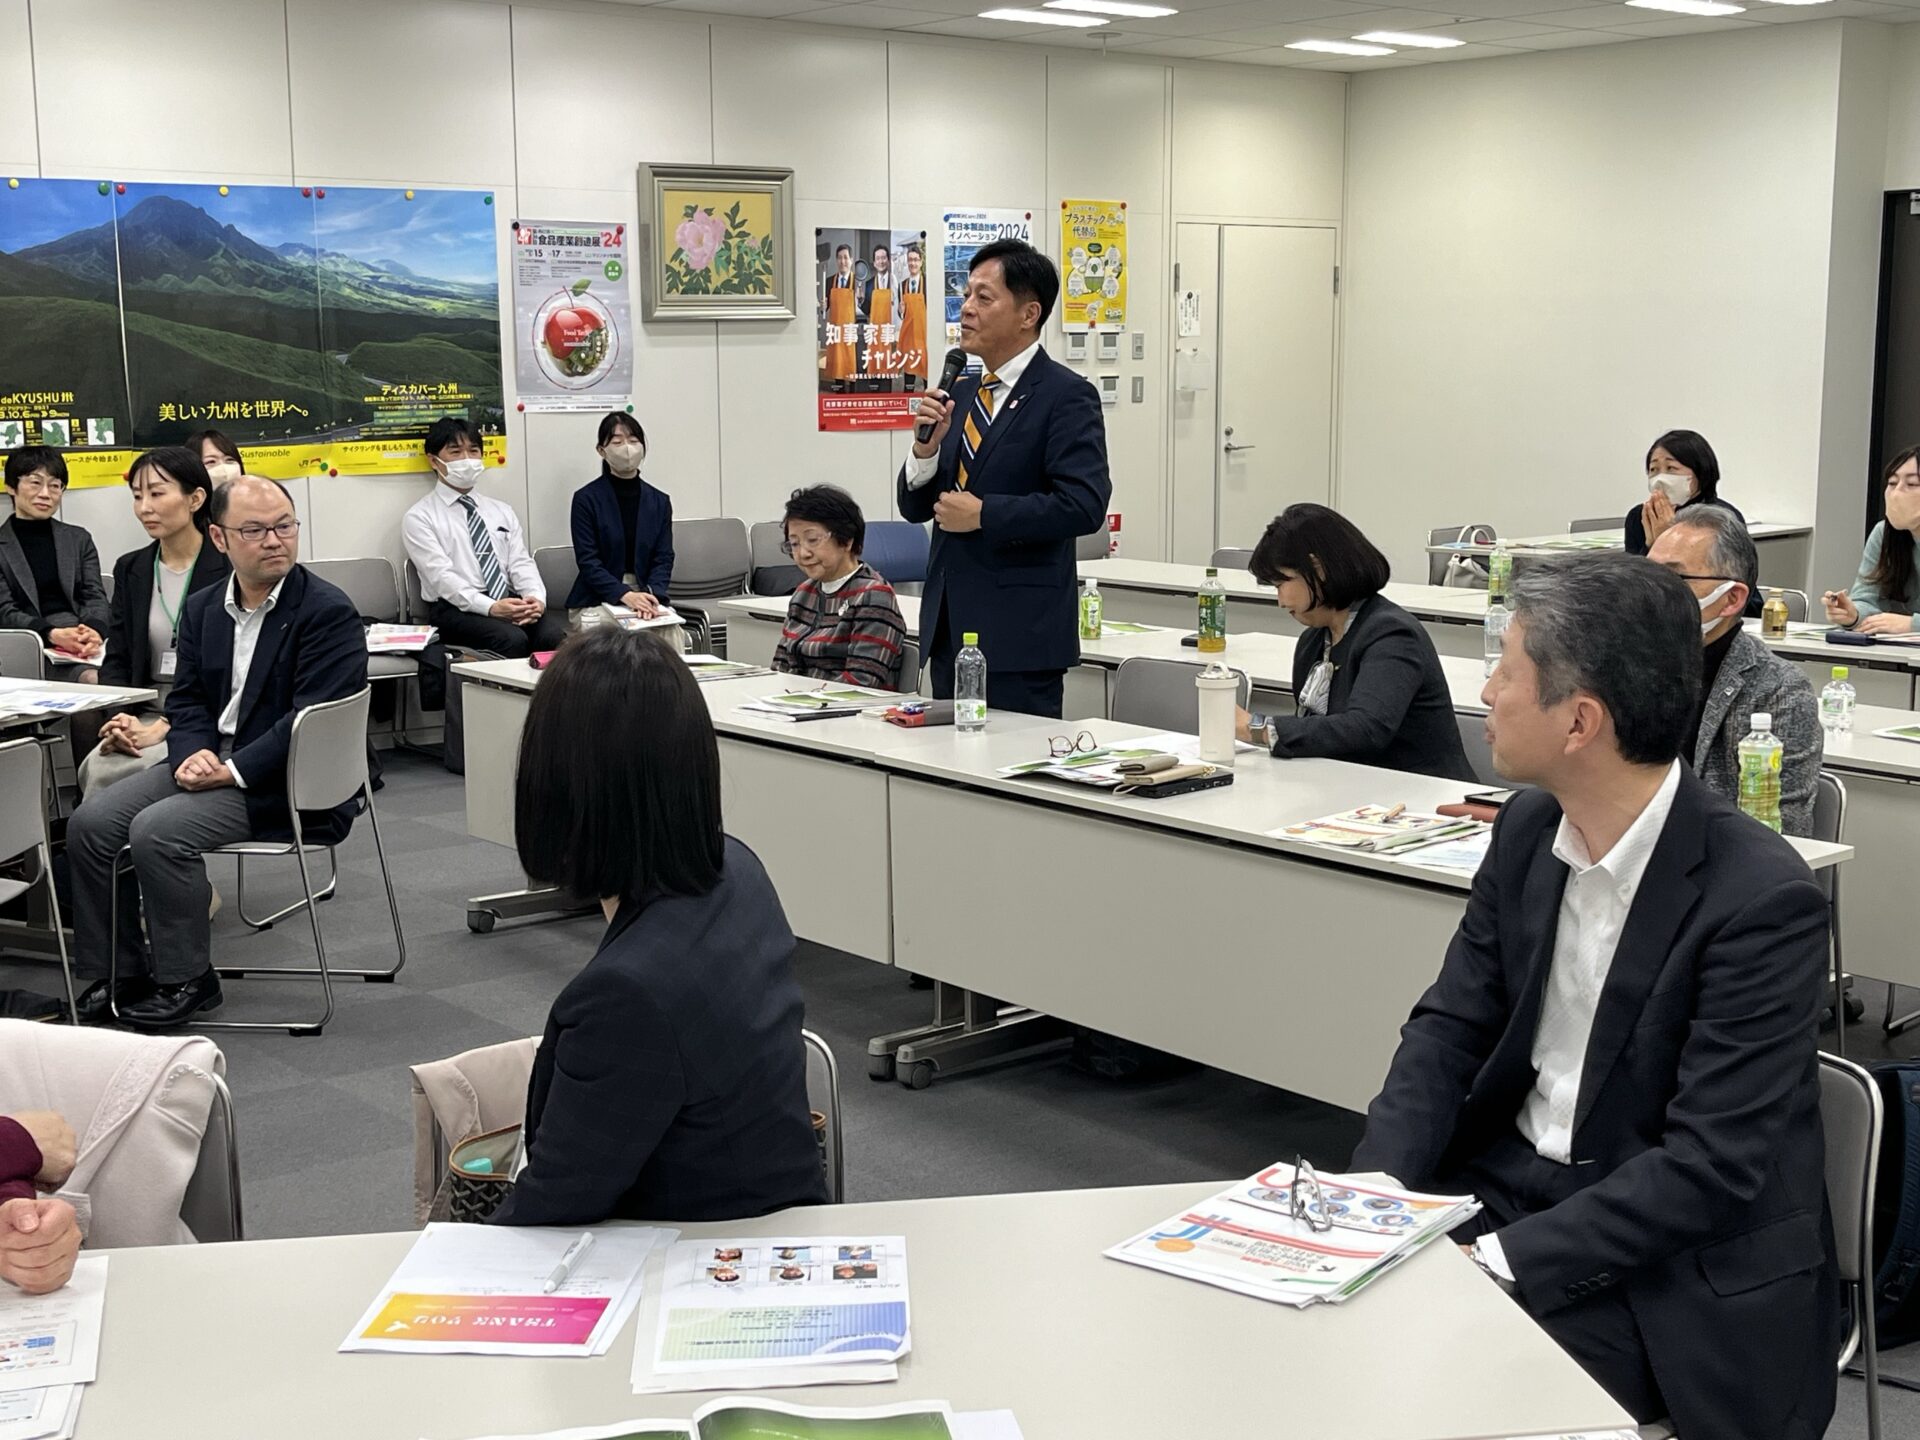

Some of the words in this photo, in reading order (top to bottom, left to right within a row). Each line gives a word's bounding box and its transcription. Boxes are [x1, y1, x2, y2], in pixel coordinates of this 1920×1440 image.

[1065, 212, 1106, 225] プラスチック
[948, 231, 998, 241] イノベーション
[998, 223, 1029, 241] 2024
[538, 234, 601, 247] 食品産業創造展
[825, 322, 859, 346] 知事
[863, 322, 896, 346] 家事
[861, 349, 923, 369] チャレンジ
[381, 383, 458, 395] ディスカバー九州
[159, 401, 309, 422] 美しい九州を世界へ。
